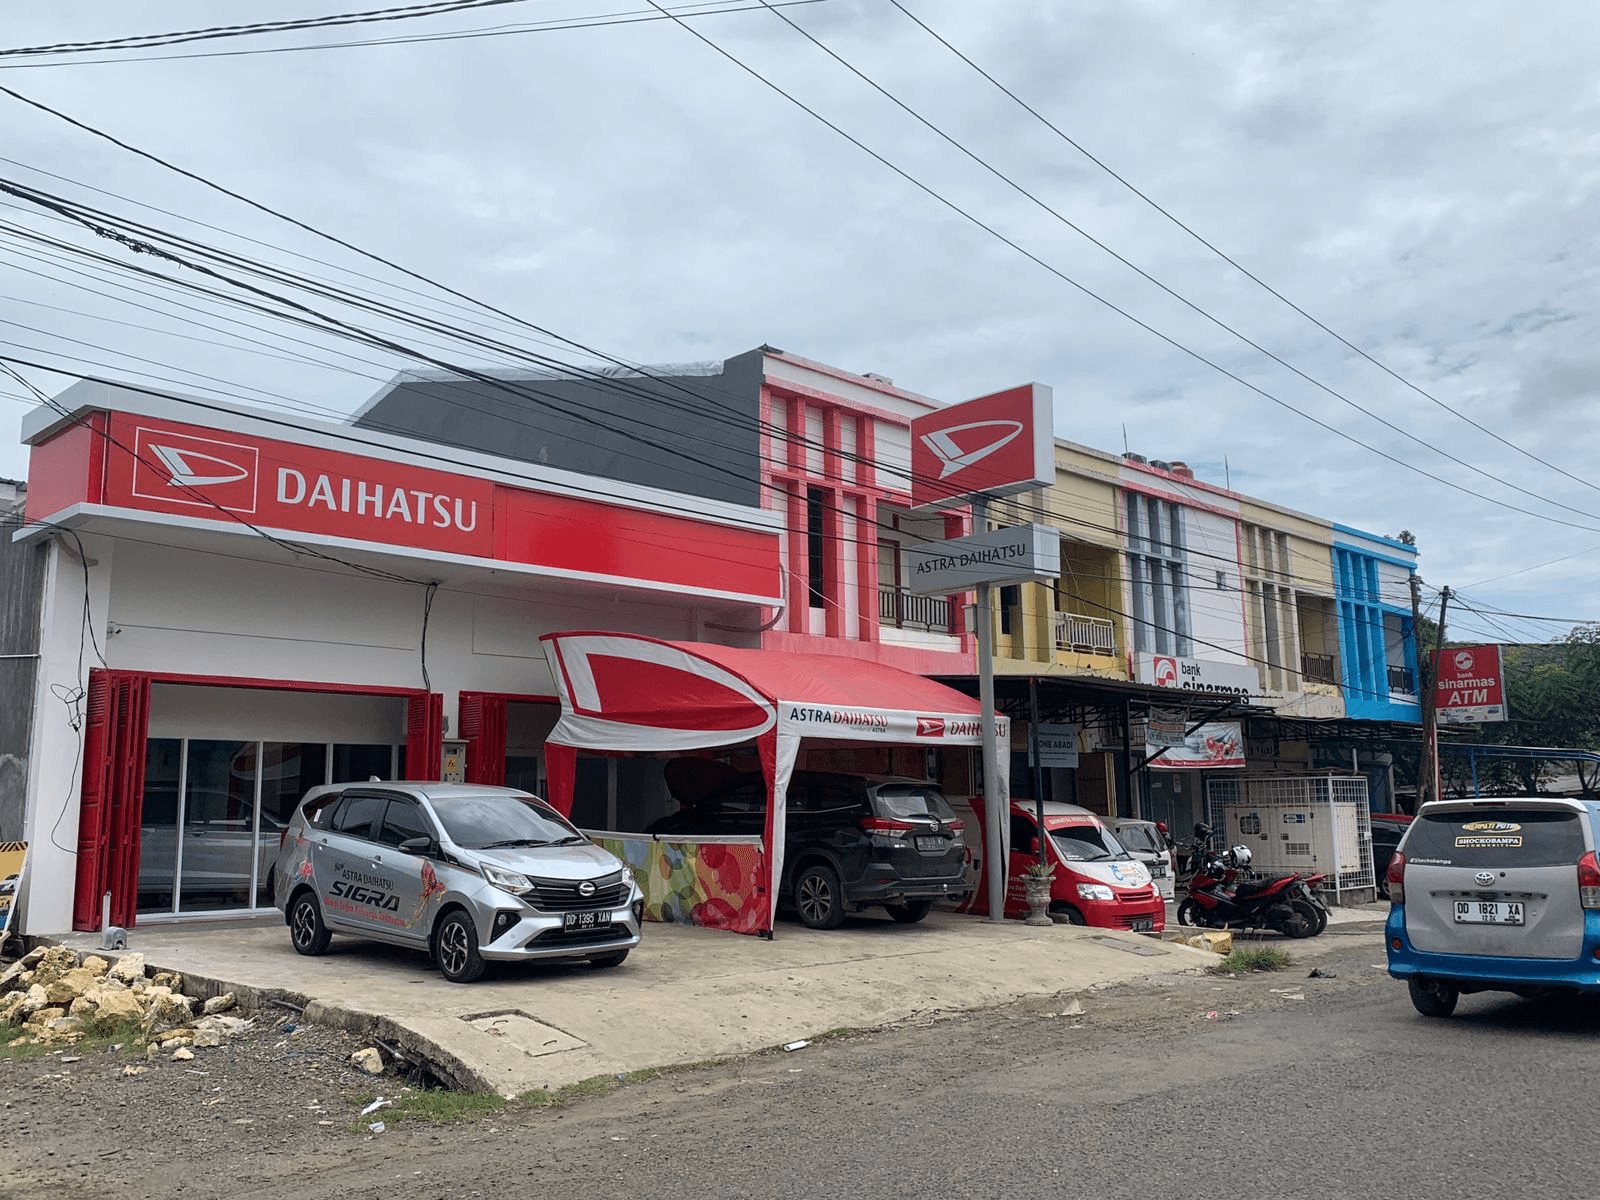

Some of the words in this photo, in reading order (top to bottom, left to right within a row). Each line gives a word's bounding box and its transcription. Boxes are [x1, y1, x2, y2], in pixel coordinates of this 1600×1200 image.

[276, 467, 477, 532] DAIHATSU
[916, 555, 956, 574] ASTRA
[959, 543, 1026, 566] DAIHATSU
[1181, 661, 1201, 676] bank
[1437, 678, 1496, 690] sinarmas
[1448, 689, 1488, 705] ATM
[790, 707, 832, 723] ASTRA
[833, 711, 888, 727] DAIHATSU
[950, 721, 1006, 738] DAIHSU
[1053, 740, 1073, 750] ABADI
[342, 870, 362, 883] ASTRA
[363, 874, 394, 891] DAIHATSU
[328, 880, 400, 912] SIGRA
[1457, 903, 1469, 914] DD
[1478, 903, 1498, 915] 1821
[1508, 904, 1520, 916] XA
[566, 914, 576, 925] DD
[579, 913, 595, 924] 1395
[598, 911, 611, 923] XAN
